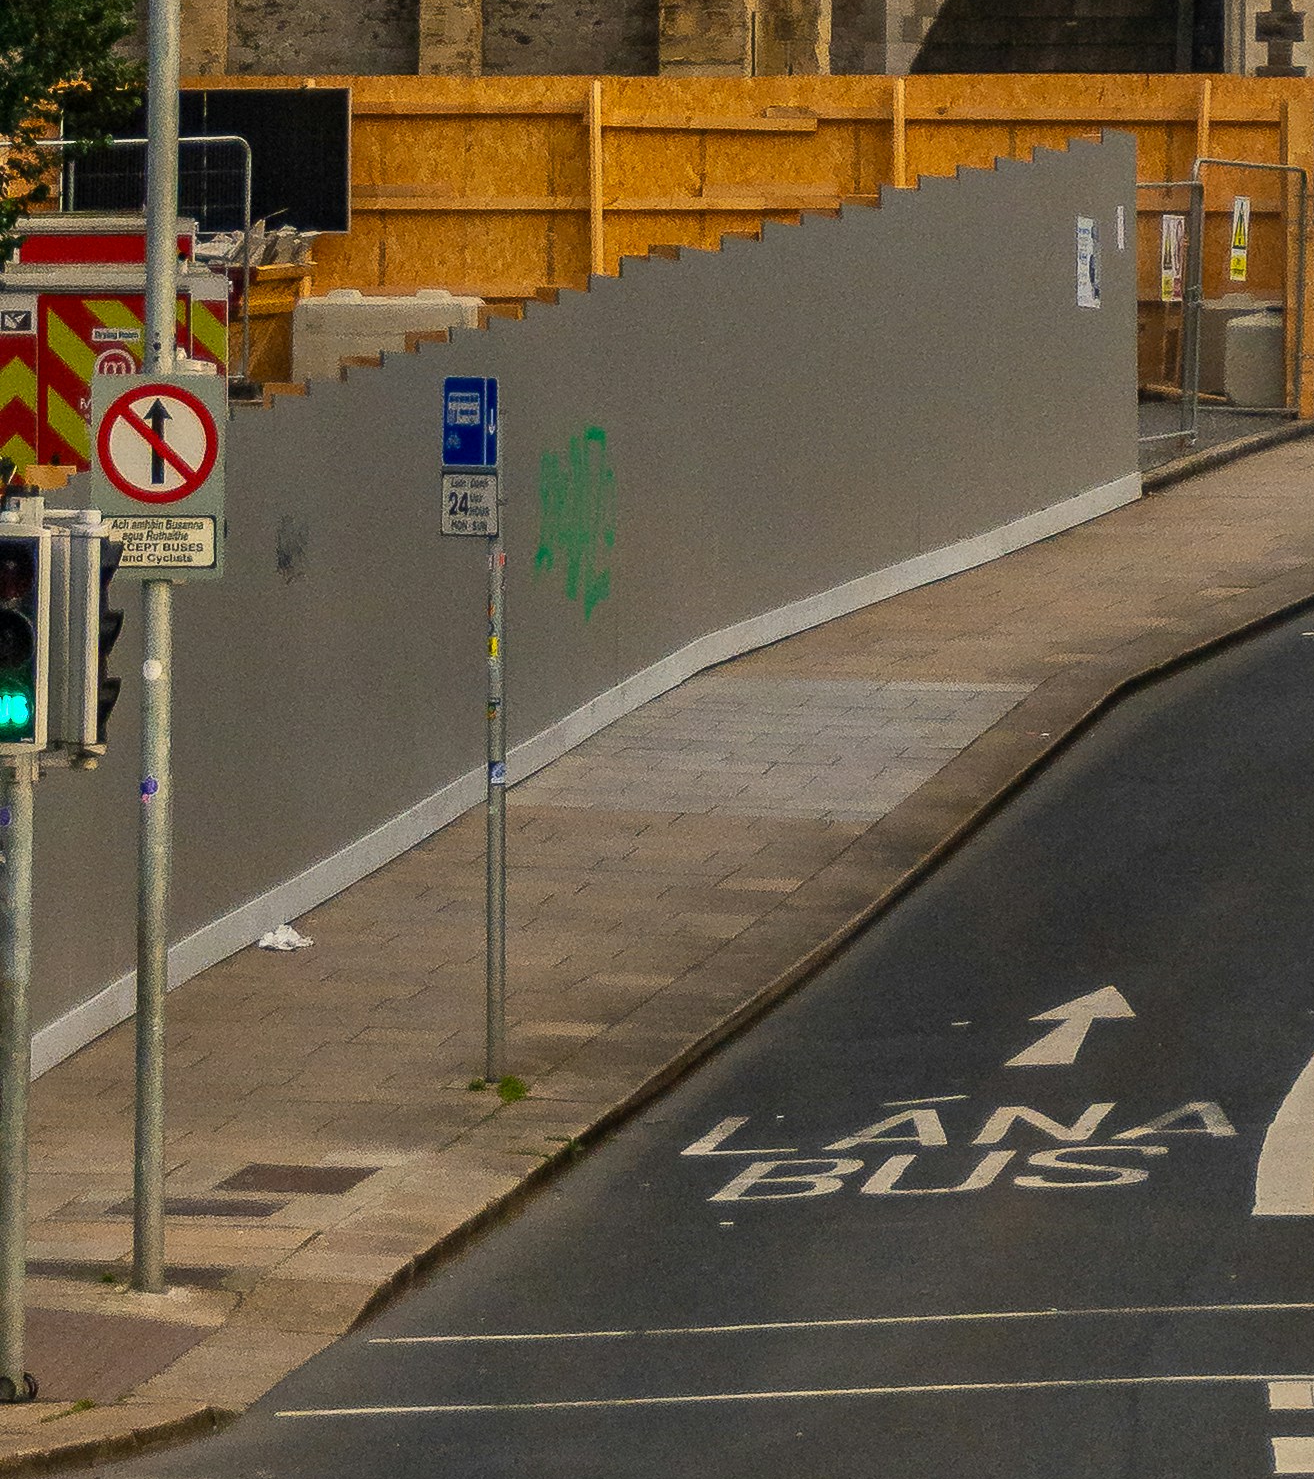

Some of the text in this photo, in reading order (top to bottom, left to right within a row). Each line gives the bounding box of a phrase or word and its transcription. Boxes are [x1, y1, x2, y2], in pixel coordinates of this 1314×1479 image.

[119, 331, 139, 339] Room
[449, 491, 468, 516] 24
[111, 519, 129, 530] Ach
[121, 532, 144, 542] agus
[162, 542, 204, 552] BUSES
[121, 554, 194, 565] and Cyclists
[681, 1094, 1239, 1156] LÁNA
[706, 1145, 1169, 1203] BUS
